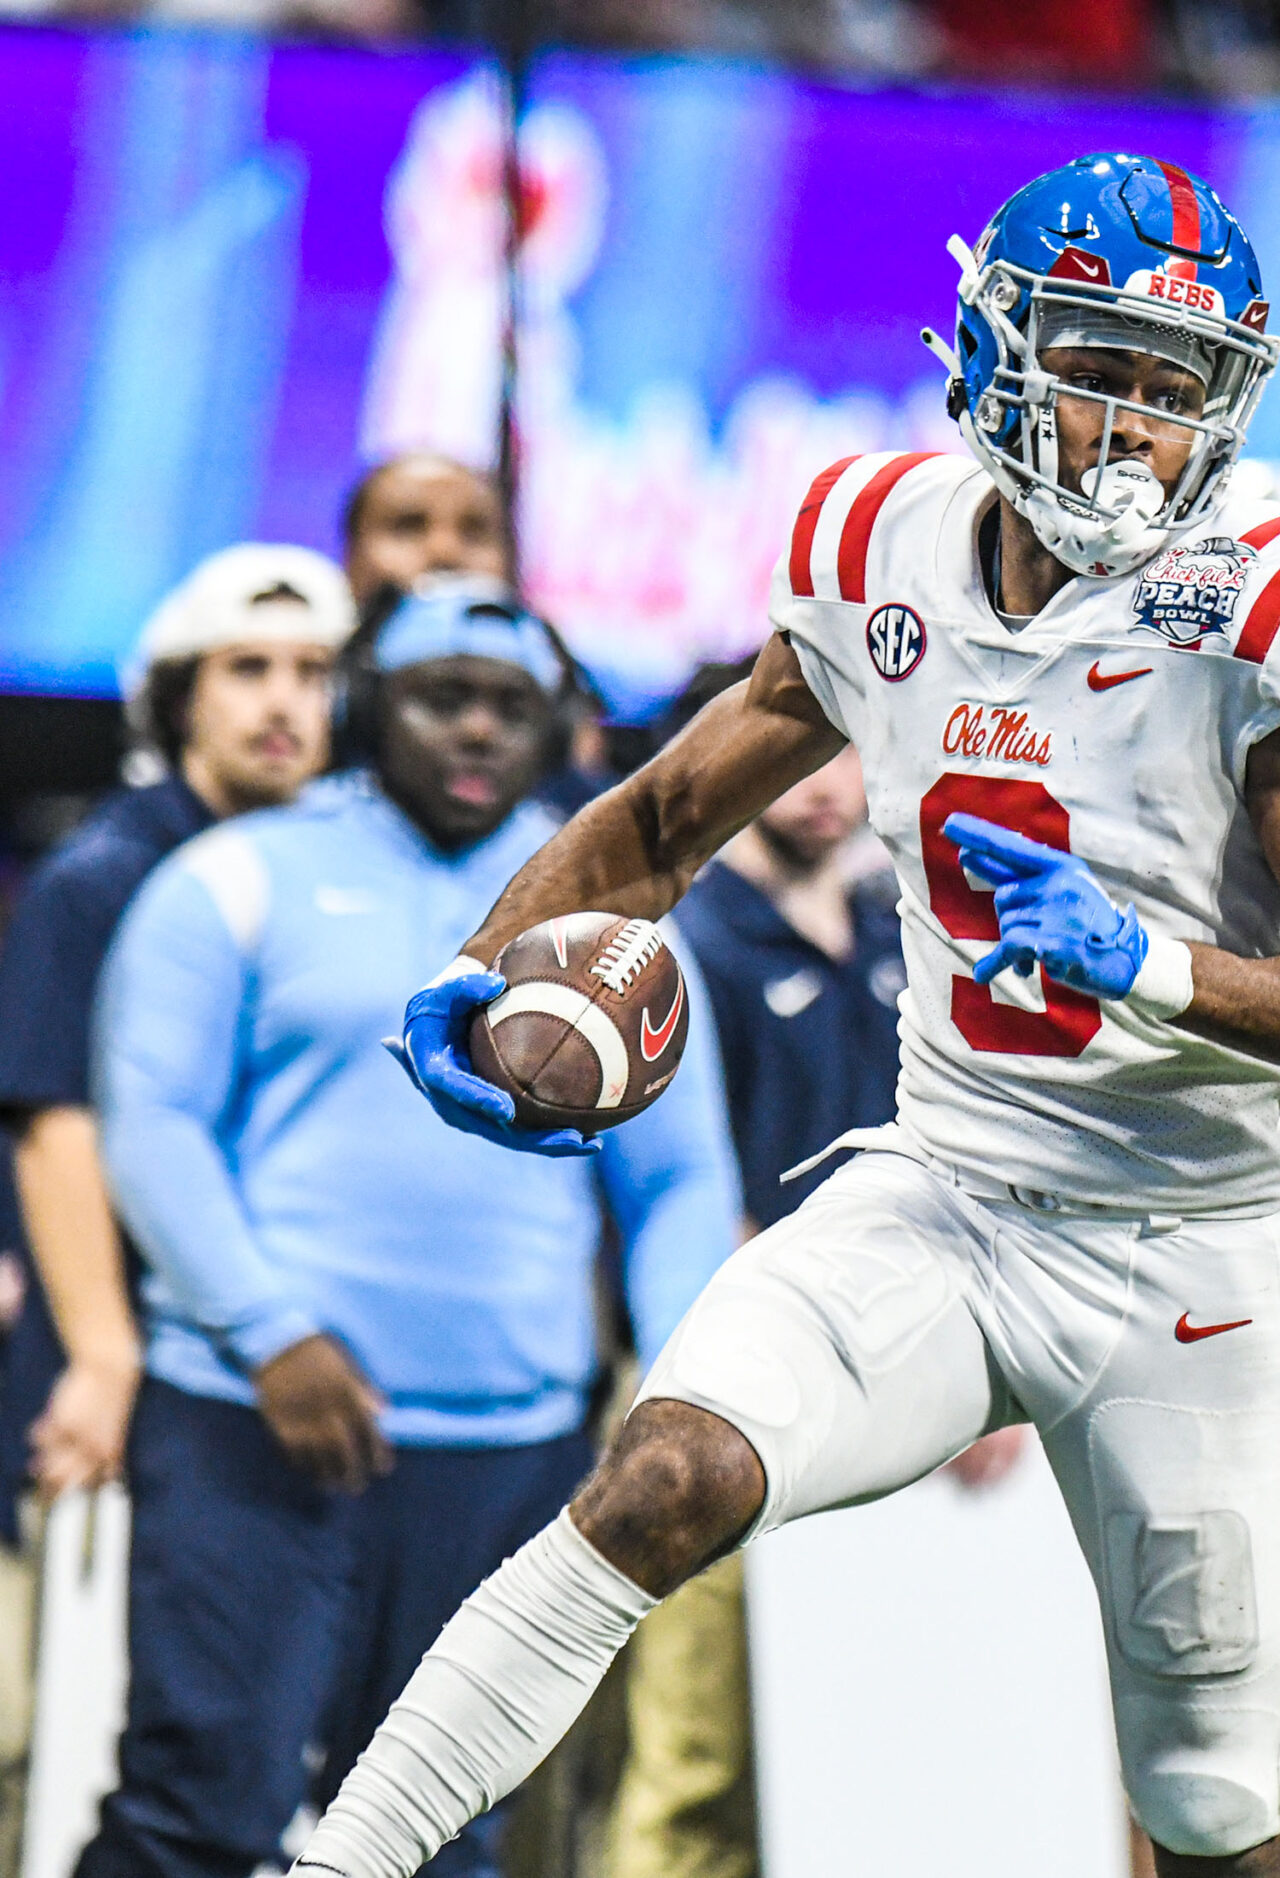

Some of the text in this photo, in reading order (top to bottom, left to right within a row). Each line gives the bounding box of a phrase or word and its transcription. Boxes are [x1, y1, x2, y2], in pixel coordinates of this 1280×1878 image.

[1148, 273, 1215, 311] REBS
[1134, 582, 1239, 619] PEACH
[1152, 608, 1211, 624] BOWL
[869, 607, 922, 677] SEC
[942, 702, 1053, 766] Ole Miss
[919, 771, 1103, 1058] 9
